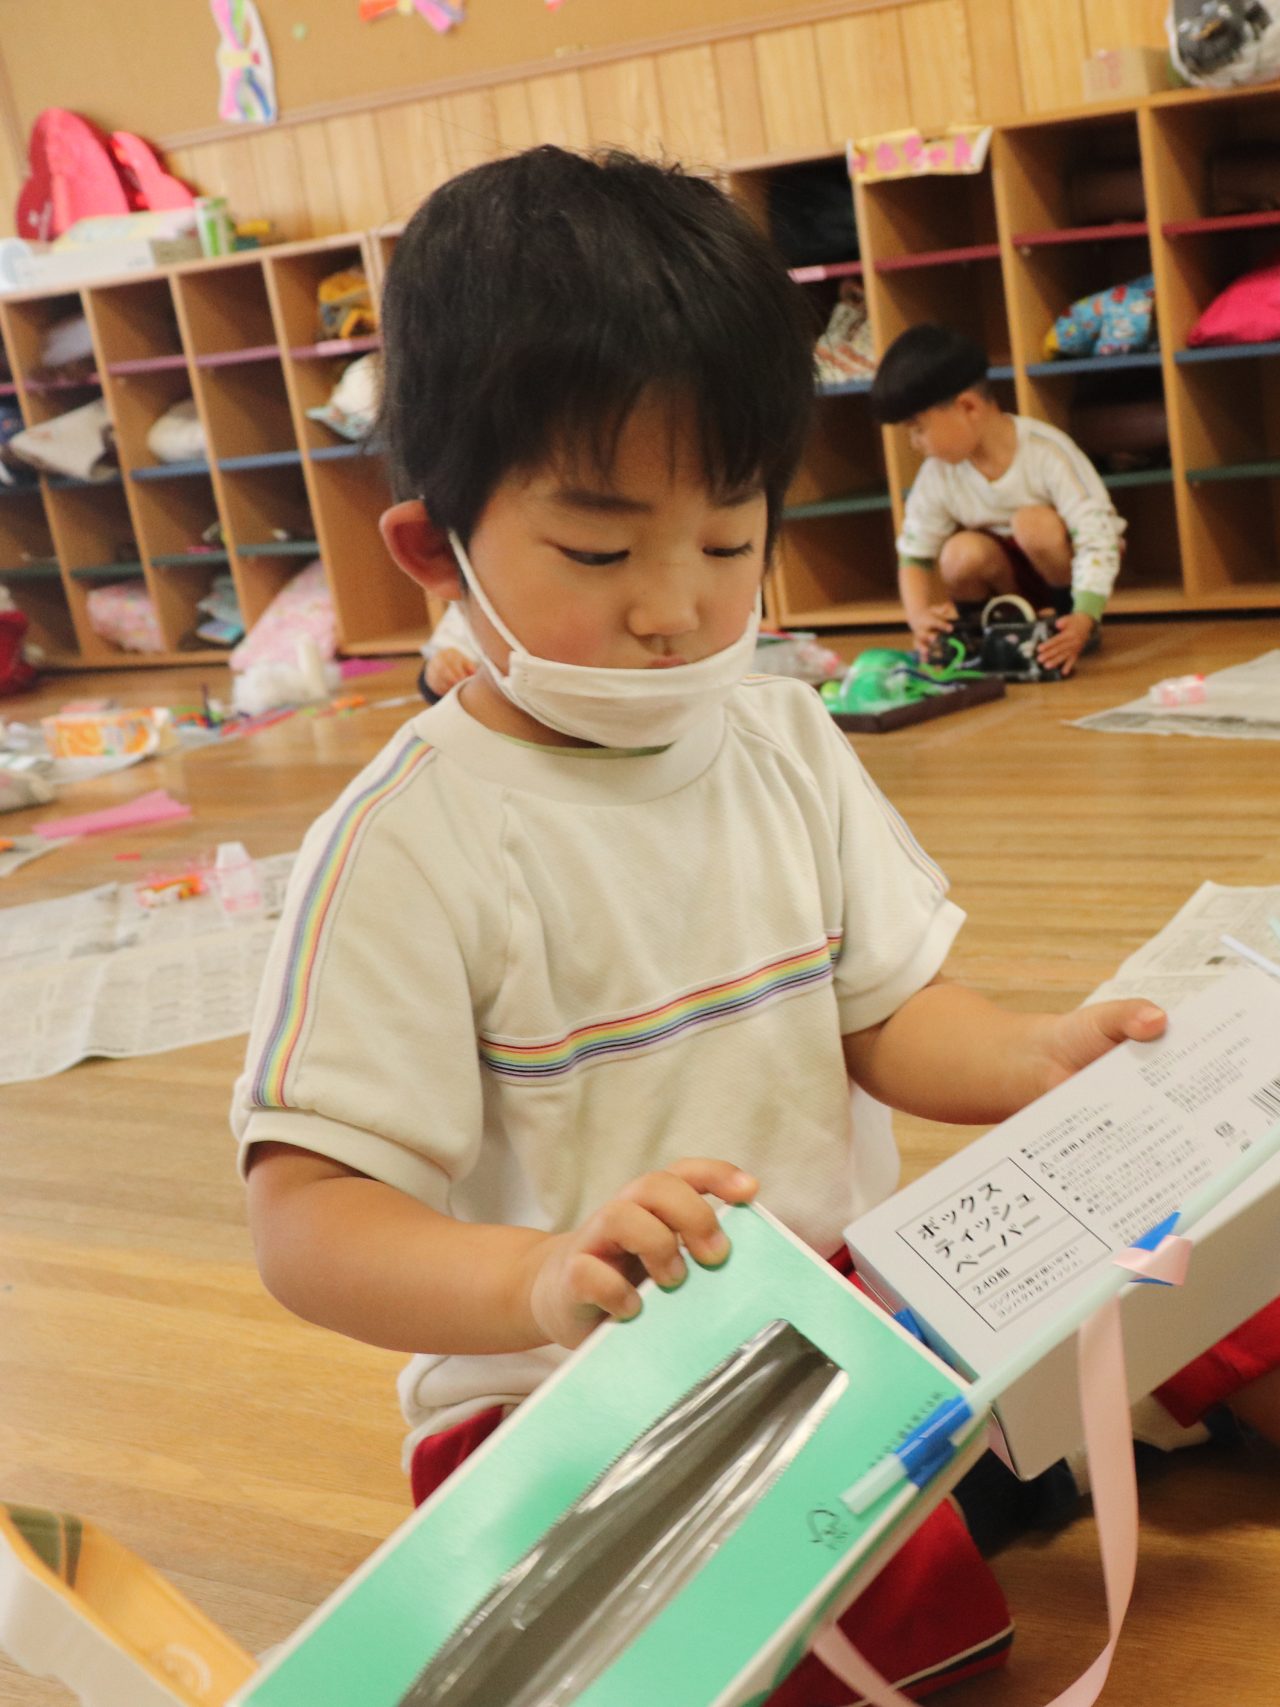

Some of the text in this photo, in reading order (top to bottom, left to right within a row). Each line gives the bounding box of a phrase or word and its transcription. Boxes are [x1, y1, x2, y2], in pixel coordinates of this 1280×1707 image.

[916, 1181, 1002, 1240] ボックス
[934, 1192, 1034, 1259] ティッシュ
[955, 1214, 1041, 1274] ペーパー
